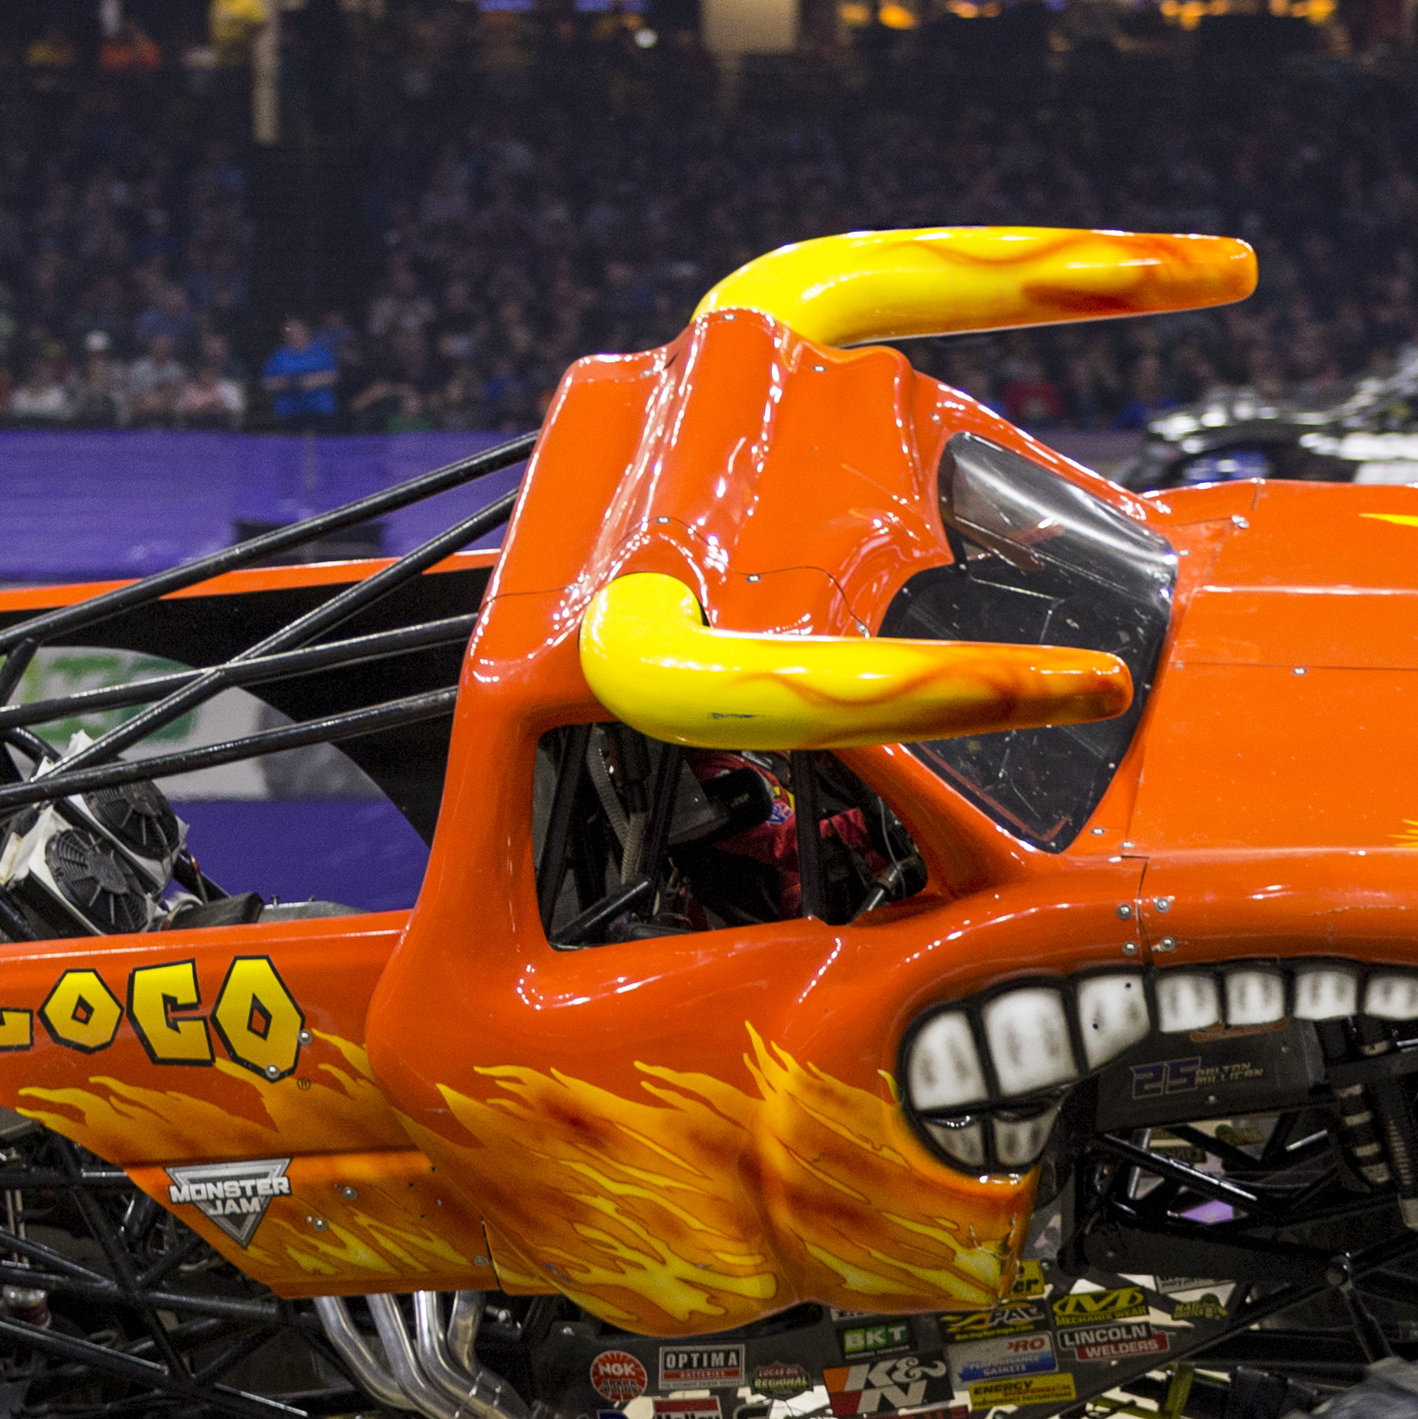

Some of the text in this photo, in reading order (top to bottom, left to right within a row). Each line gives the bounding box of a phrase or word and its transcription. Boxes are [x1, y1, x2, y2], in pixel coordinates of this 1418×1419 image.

[170, 1176, 290, 1205] MONSTER
[210, 1198, 261, 1217] JAM
[1115, 1305, 1147, 1319] WEAR
[845, 1324, 907, 1349] BKT
[1064, 1325, 1147, 1346] LINCOLN
[1085, 1339, 1158, 1358] WELDERS
[598, 1362, 636, 1377] NGK
[666, 1351, 738, 1369] OPTIMA
[844, 1356, 947, 1414] K&N
[974, 1380, 1033, 1395] ENERGY
